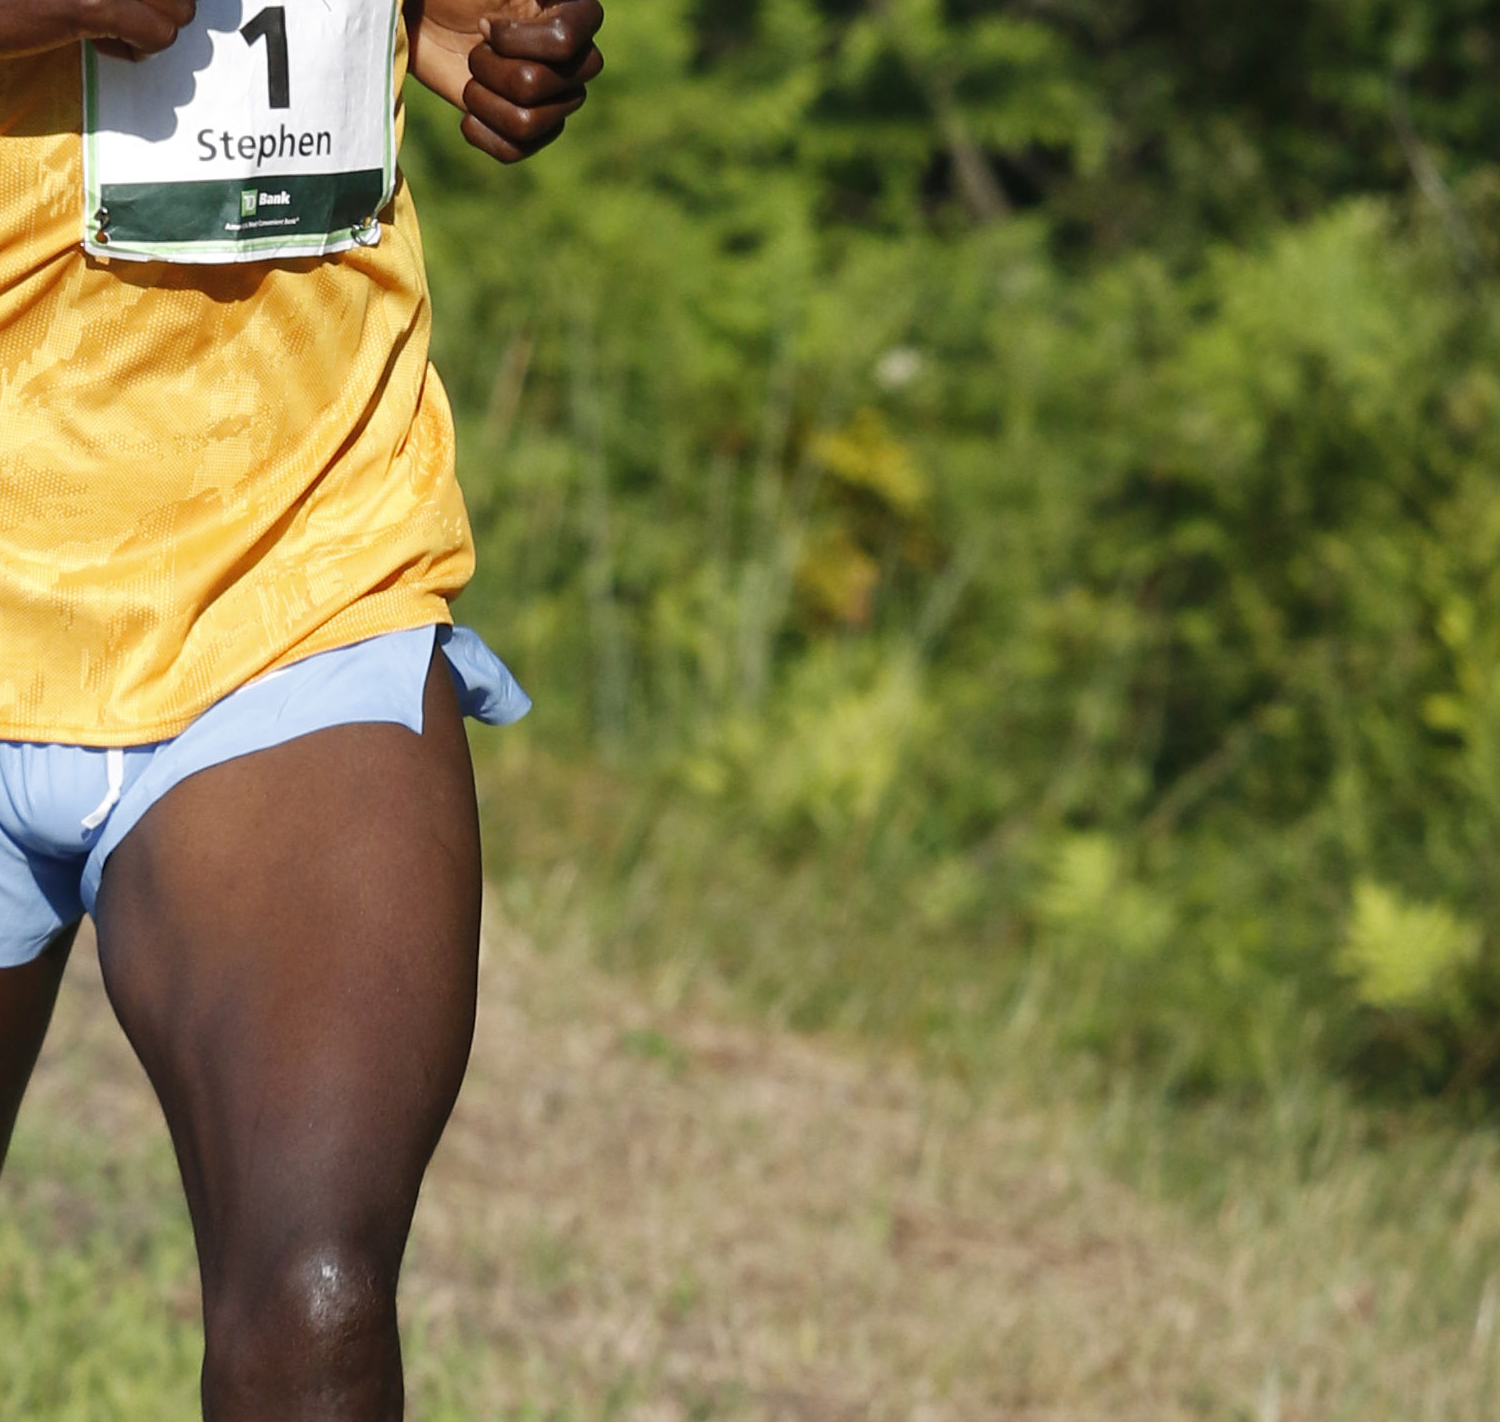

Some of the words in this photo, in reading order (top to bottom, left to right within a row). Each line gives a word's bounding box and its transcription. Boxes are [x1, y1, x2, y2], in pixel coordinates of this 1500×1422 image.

[240, 6, 290, 108] 1
[197, 124, 332, 167] Stephen
[259, 190, 290, 206] Bank
